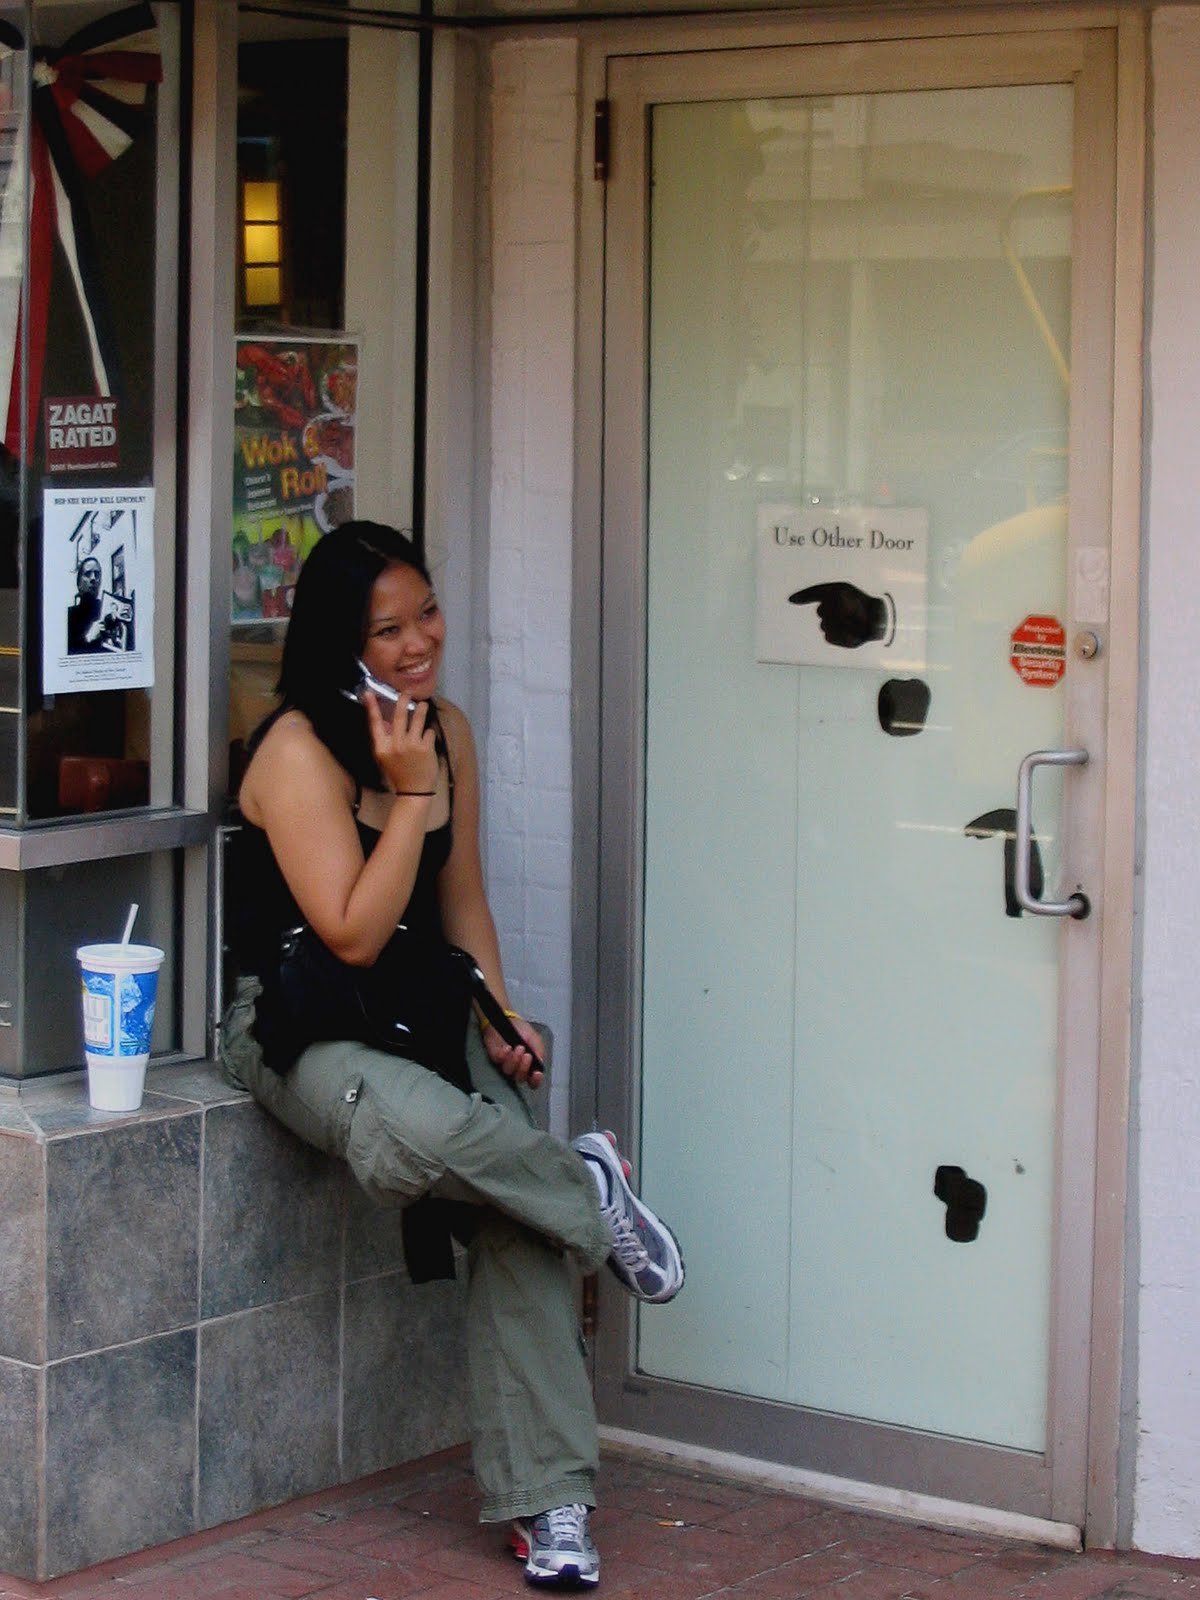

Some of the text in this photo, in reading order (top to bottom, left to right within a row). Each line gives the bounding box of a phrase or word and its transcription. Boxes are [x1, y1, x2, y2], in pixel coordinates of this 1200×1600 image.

[49, 403, 117, 426] ZAGAT
[49, 426, 117, 449] RATED
[241, 426, 320, 470] Wok &
[281, 462, 328, 501] Roll
[775, 526, 914, 550] Use Other Door
[1020, 667, 1059, 680] System
